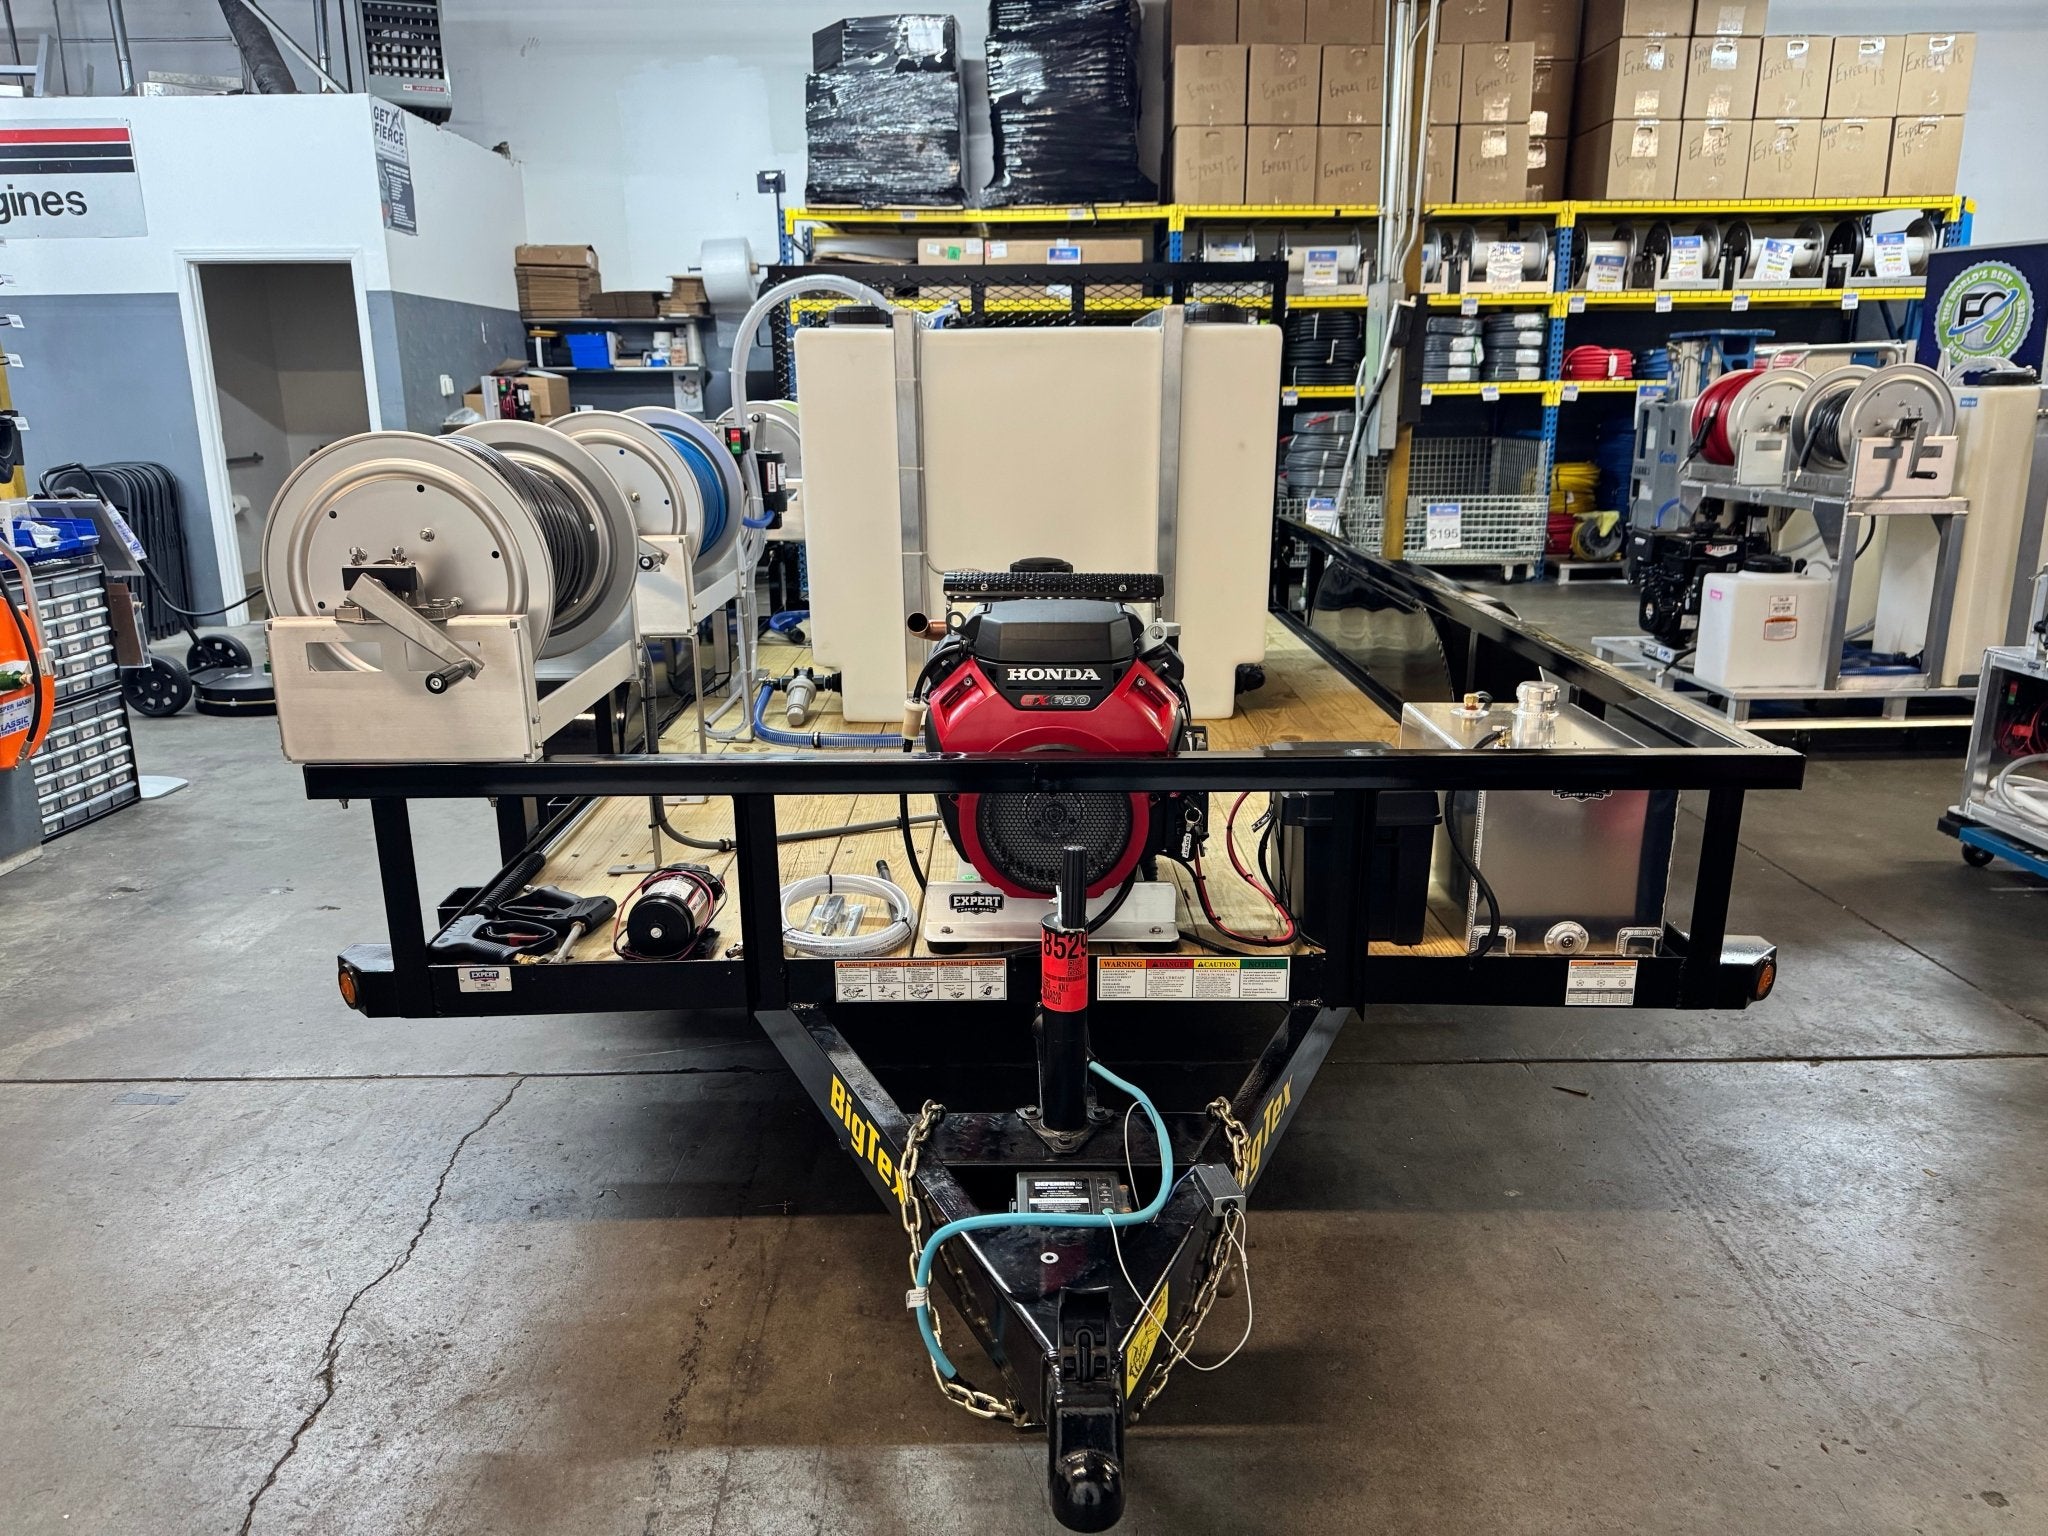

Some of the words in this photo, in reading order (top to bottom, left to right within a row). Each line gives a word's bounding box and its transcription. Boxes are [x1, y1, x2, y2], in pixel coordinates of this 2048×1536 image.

[1951, 45, 1965, 64] 18
[1366, 76, 1380, 93] 12
[1874, 69, 1886, 86] 18
[373, 105, 390, 124] GET
[374, 122, 404, 146] FIERCE
[1360, 158, 1372, 173] 12
[1777, 152, 1793, 173] 18
[1942, 300, 1954, 322] THE
[1949, 269, 1989, 304] WORLD'S
[1990, 269, 2014, 285] BEST
[1429, 528, 1458, 540] $195
[1007, 668, 1101, 681] HONDA
[953, 895, 1001, 907] EXPERT
[1104, 960, 1143, 968] WARNING
[1159, 960, 1189, 968] DANGER
[1203, 960, 1237, 968] CAUTION
[830, 1073, 906, 1206] BigTex
